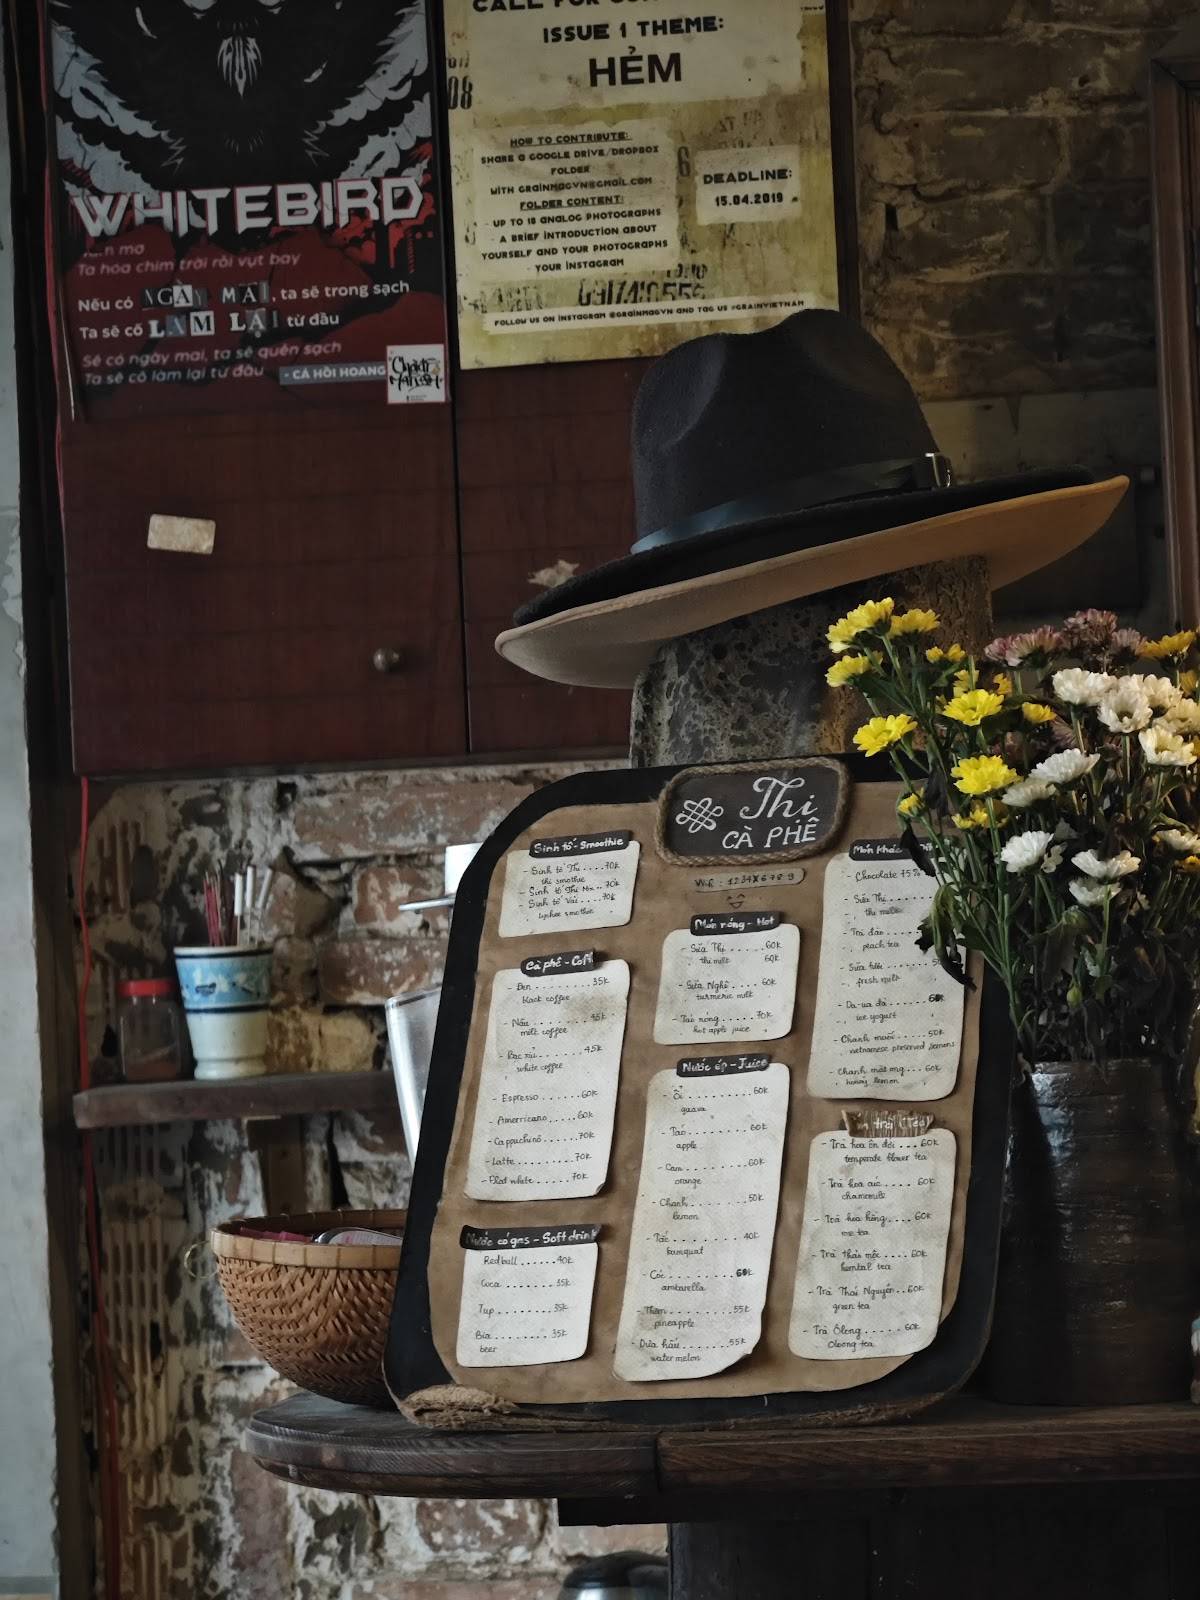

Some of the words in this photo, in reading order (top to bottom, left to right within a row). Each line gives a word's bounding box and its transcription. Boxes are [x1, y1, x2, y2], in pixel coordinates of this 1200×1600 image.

[543, 24, 609, 43] ISSUE
[619, 22, 627, 38] 1
[639, 16, 724, 36] THEME:
[589, 46, 682, 87] HẺM
[510, 138, 533, 147] HOW
[537, 136, 552, 146] TO
[556, 131, 629, 143] CONTRIBUTE:
[551, 165, 591, 175] FOLDER
[703, 169, 792, 185] DEADLINE:
[71, 176, 423, 237] WHITEBIRD
[520, 199, 563, 210] FOLDER
[715, 192, 784, 207] 15.04.2019
[493, 218, 506, 228] UP
[510, 218, 523, 227] TO
[269, 252, 301, 267] bay
[481, 249, 532, 261] YOURSELF
[562, 245, 589, 254] YOUR
[535, 263, 562, 273] YOUR
[115, 295, 134, 310] có
[280, 288, 297, 301] ta
[302, 285, 320, 299] sẽ
[325, 283, 369, 299] trong
[373, 280, 410, 297] sạch
[79, 326, 99, 340] Ta
[102, 323, 120, 338] sẽ
[309, 312, 340, 327] đầu
[213, 348, 231, 360] ta
[303, 341, 342, 357] sạch
[339, 365, 386, 378] HOANG
[722, 825, 753, 850] CÀ
[764, 817, 820, 848] PHÊ
[580, 837, 624, 850] Smoothie
[855, 870, 898, 883] Chocolate
[581, 1090, 599, 1099] 60k
[578, 1132, 595, 1140] 70k
[575, 1152, 592, 1161] 70k
[571, 1172, 589, 1181] 70k
